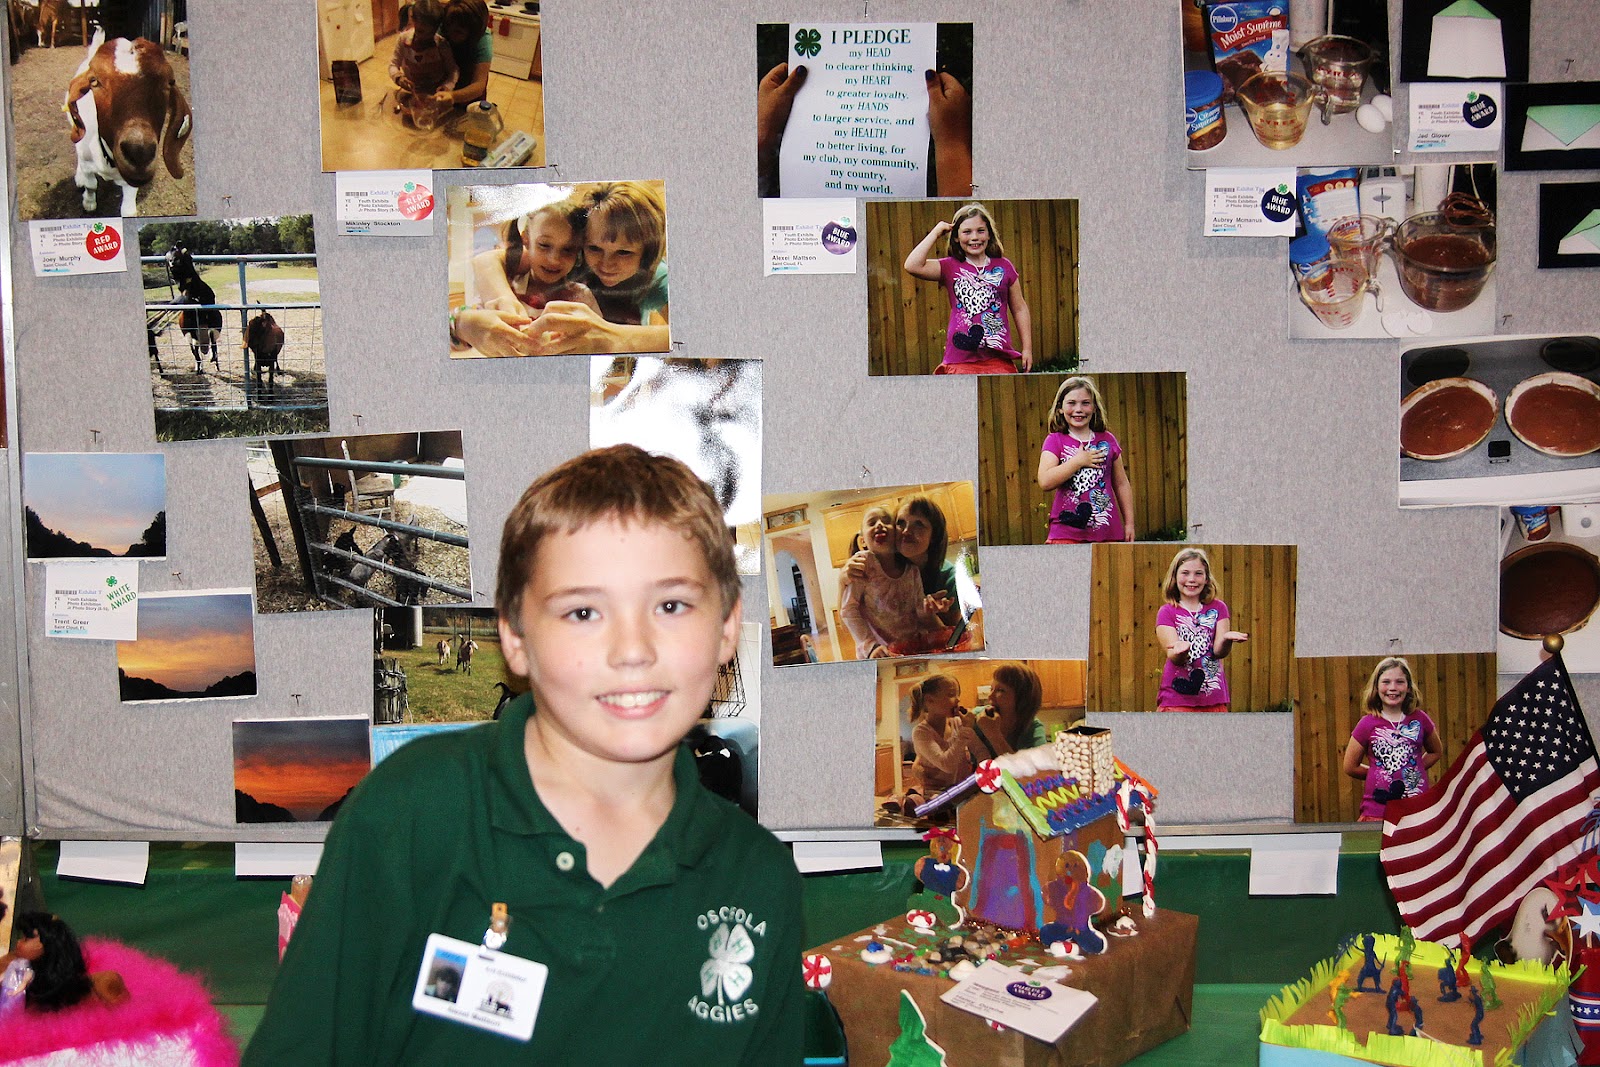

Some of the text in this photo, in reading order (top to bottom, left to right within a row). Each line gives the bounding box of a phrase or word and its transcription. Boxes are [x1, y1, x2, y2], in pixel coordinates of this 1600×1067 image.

[1212, 16, 1236, 24] Pillsbury
[831, 29, 911, 44] I PLEDGE
[1220, 28, 1246, 49] Moist
[849, 47, 891, 59] my HEAD
[825, 63, 834, 71] to
[836, 63, 869, 71] clearer
[845, 75, 892, 86] my HEART
[826, 89, 835, 97] to
[837, 90, 871, 99] greater
[840, 102, 889, 111] my HANDS
[812, 114, 822, 122] to
[824, 114, 852, 124] larger
[895, 117, 915, 126] and
[834, 127, 888, 139] my HEALTH
[816, 141, 825, 150] to
[827, 141, 855, 152] better
[891, 145, 906, 155] for
[803, 154, 816, 163] my
[844, 158, 859, 167] my
[830, 169, 845, 178] my
[824, 181, 893, 195] and my world.
[406, 199, 431, 214] AWARD
[1271, 195, 1289, 206] BLUE
[1265, 202, 1291, 215] AWARD
[832, 227, 850, 239] BLUE
[94, 235, 111, 246] RED
[825, 233, 851, 248] AWARD
[93, 241, 119, 254] AWARD
[106, 583, 131, 601] WHITE
[110, 591, 137, 610] AWARD
[697, 906, 767, 937] OSCEOLA
[1013, 983, 1047, 995] PURPLE
[688, 995, 759, 1024] AGGIES
